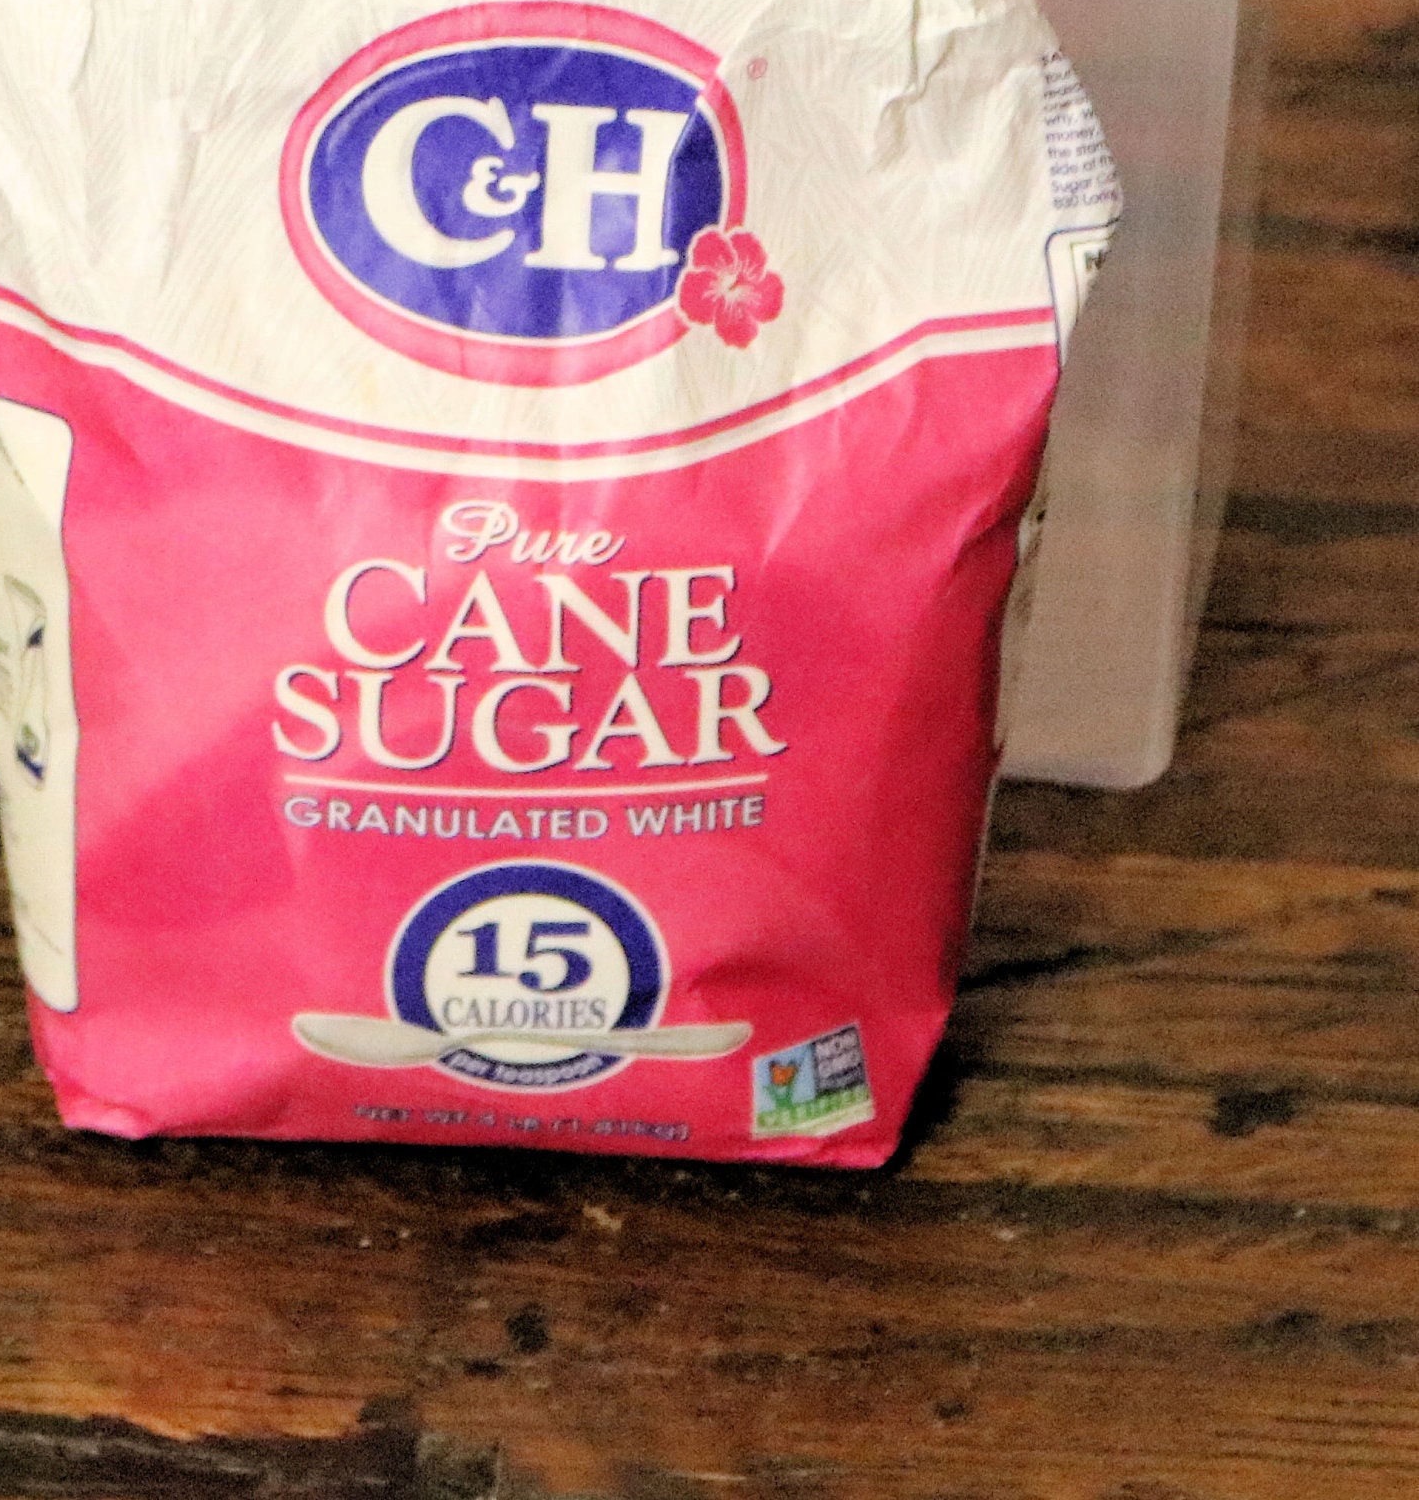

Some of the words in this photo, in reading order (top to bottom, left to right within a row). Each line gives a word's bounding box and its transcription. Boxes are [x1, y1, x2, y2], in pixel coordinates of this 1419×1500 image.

[441, 499, 623, 565] Pure
[323, 558, 741, 672] CANE
[272, 663, 788, 773] SUGAR
[283, 796, 609, 841] GRANULATED
[627, 794, 765, 836] WHITE
[456, 921, 592, 993] 15
[442, 995, 607, 1031] CALORIES
